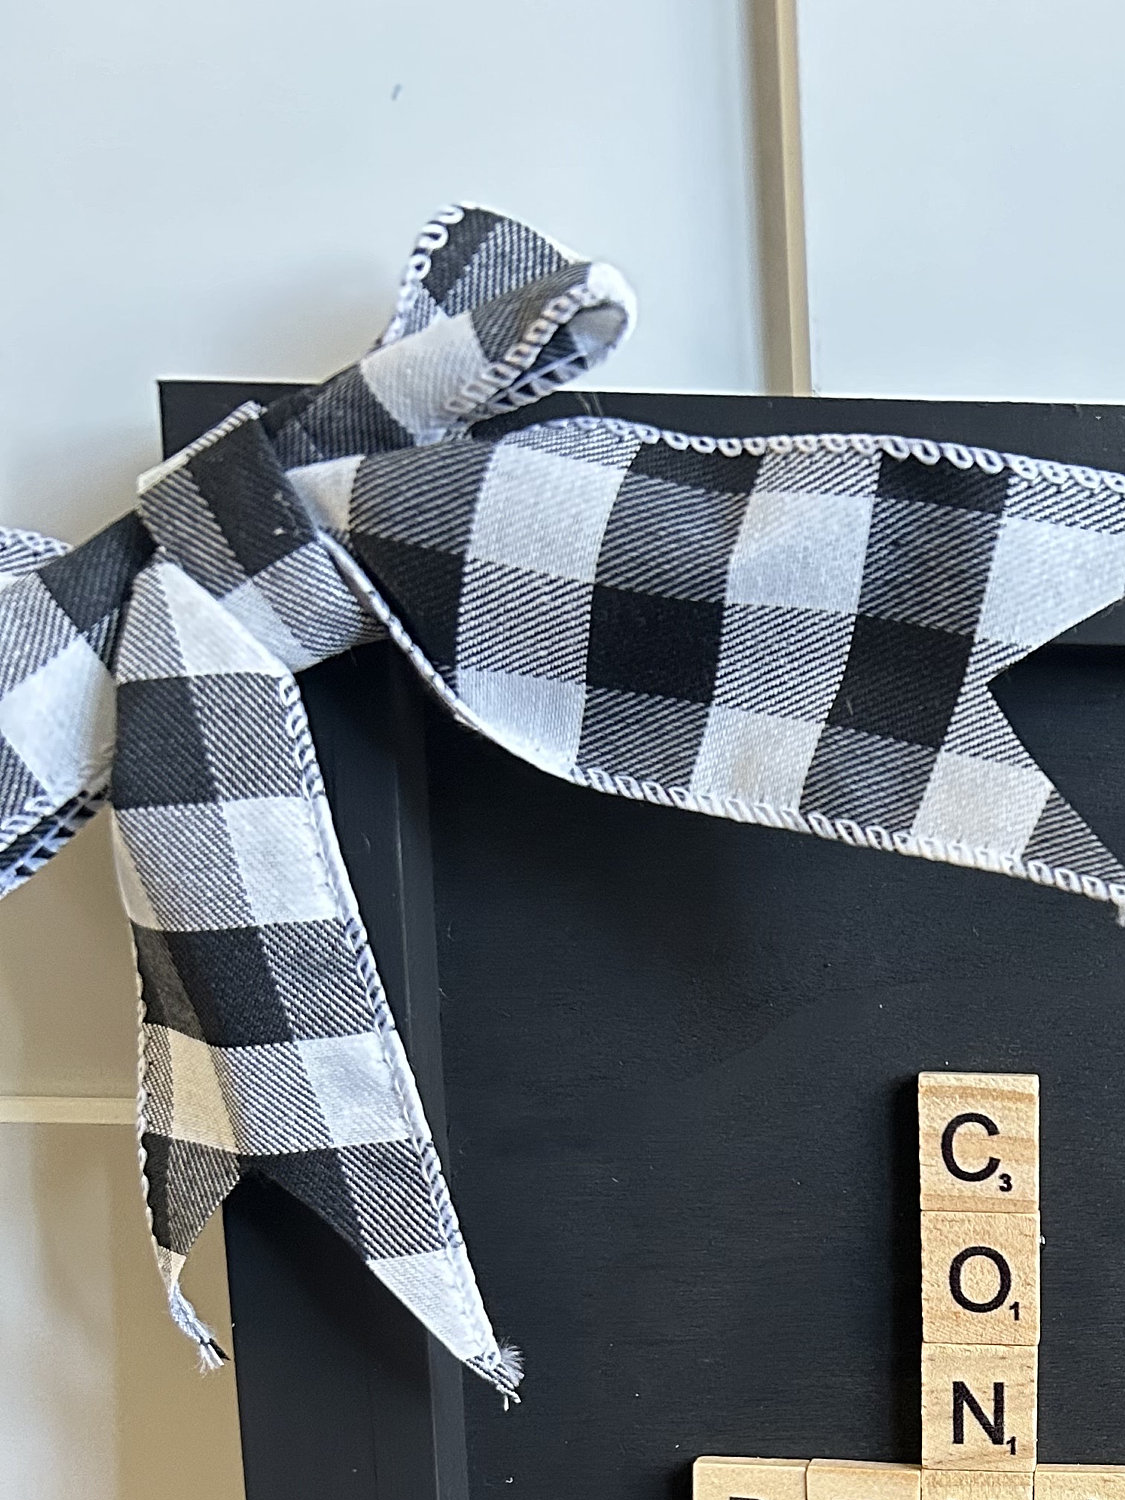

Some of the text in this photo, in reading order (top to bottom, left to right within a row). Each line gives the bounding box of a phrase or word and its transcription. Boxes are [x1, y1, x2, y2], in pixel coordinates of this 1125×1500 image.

[998, 1173, 1014, 1193] 3
[1008, 1301, 1021, 1321] 1
[1005, 1435, 1018, 1456] 1
